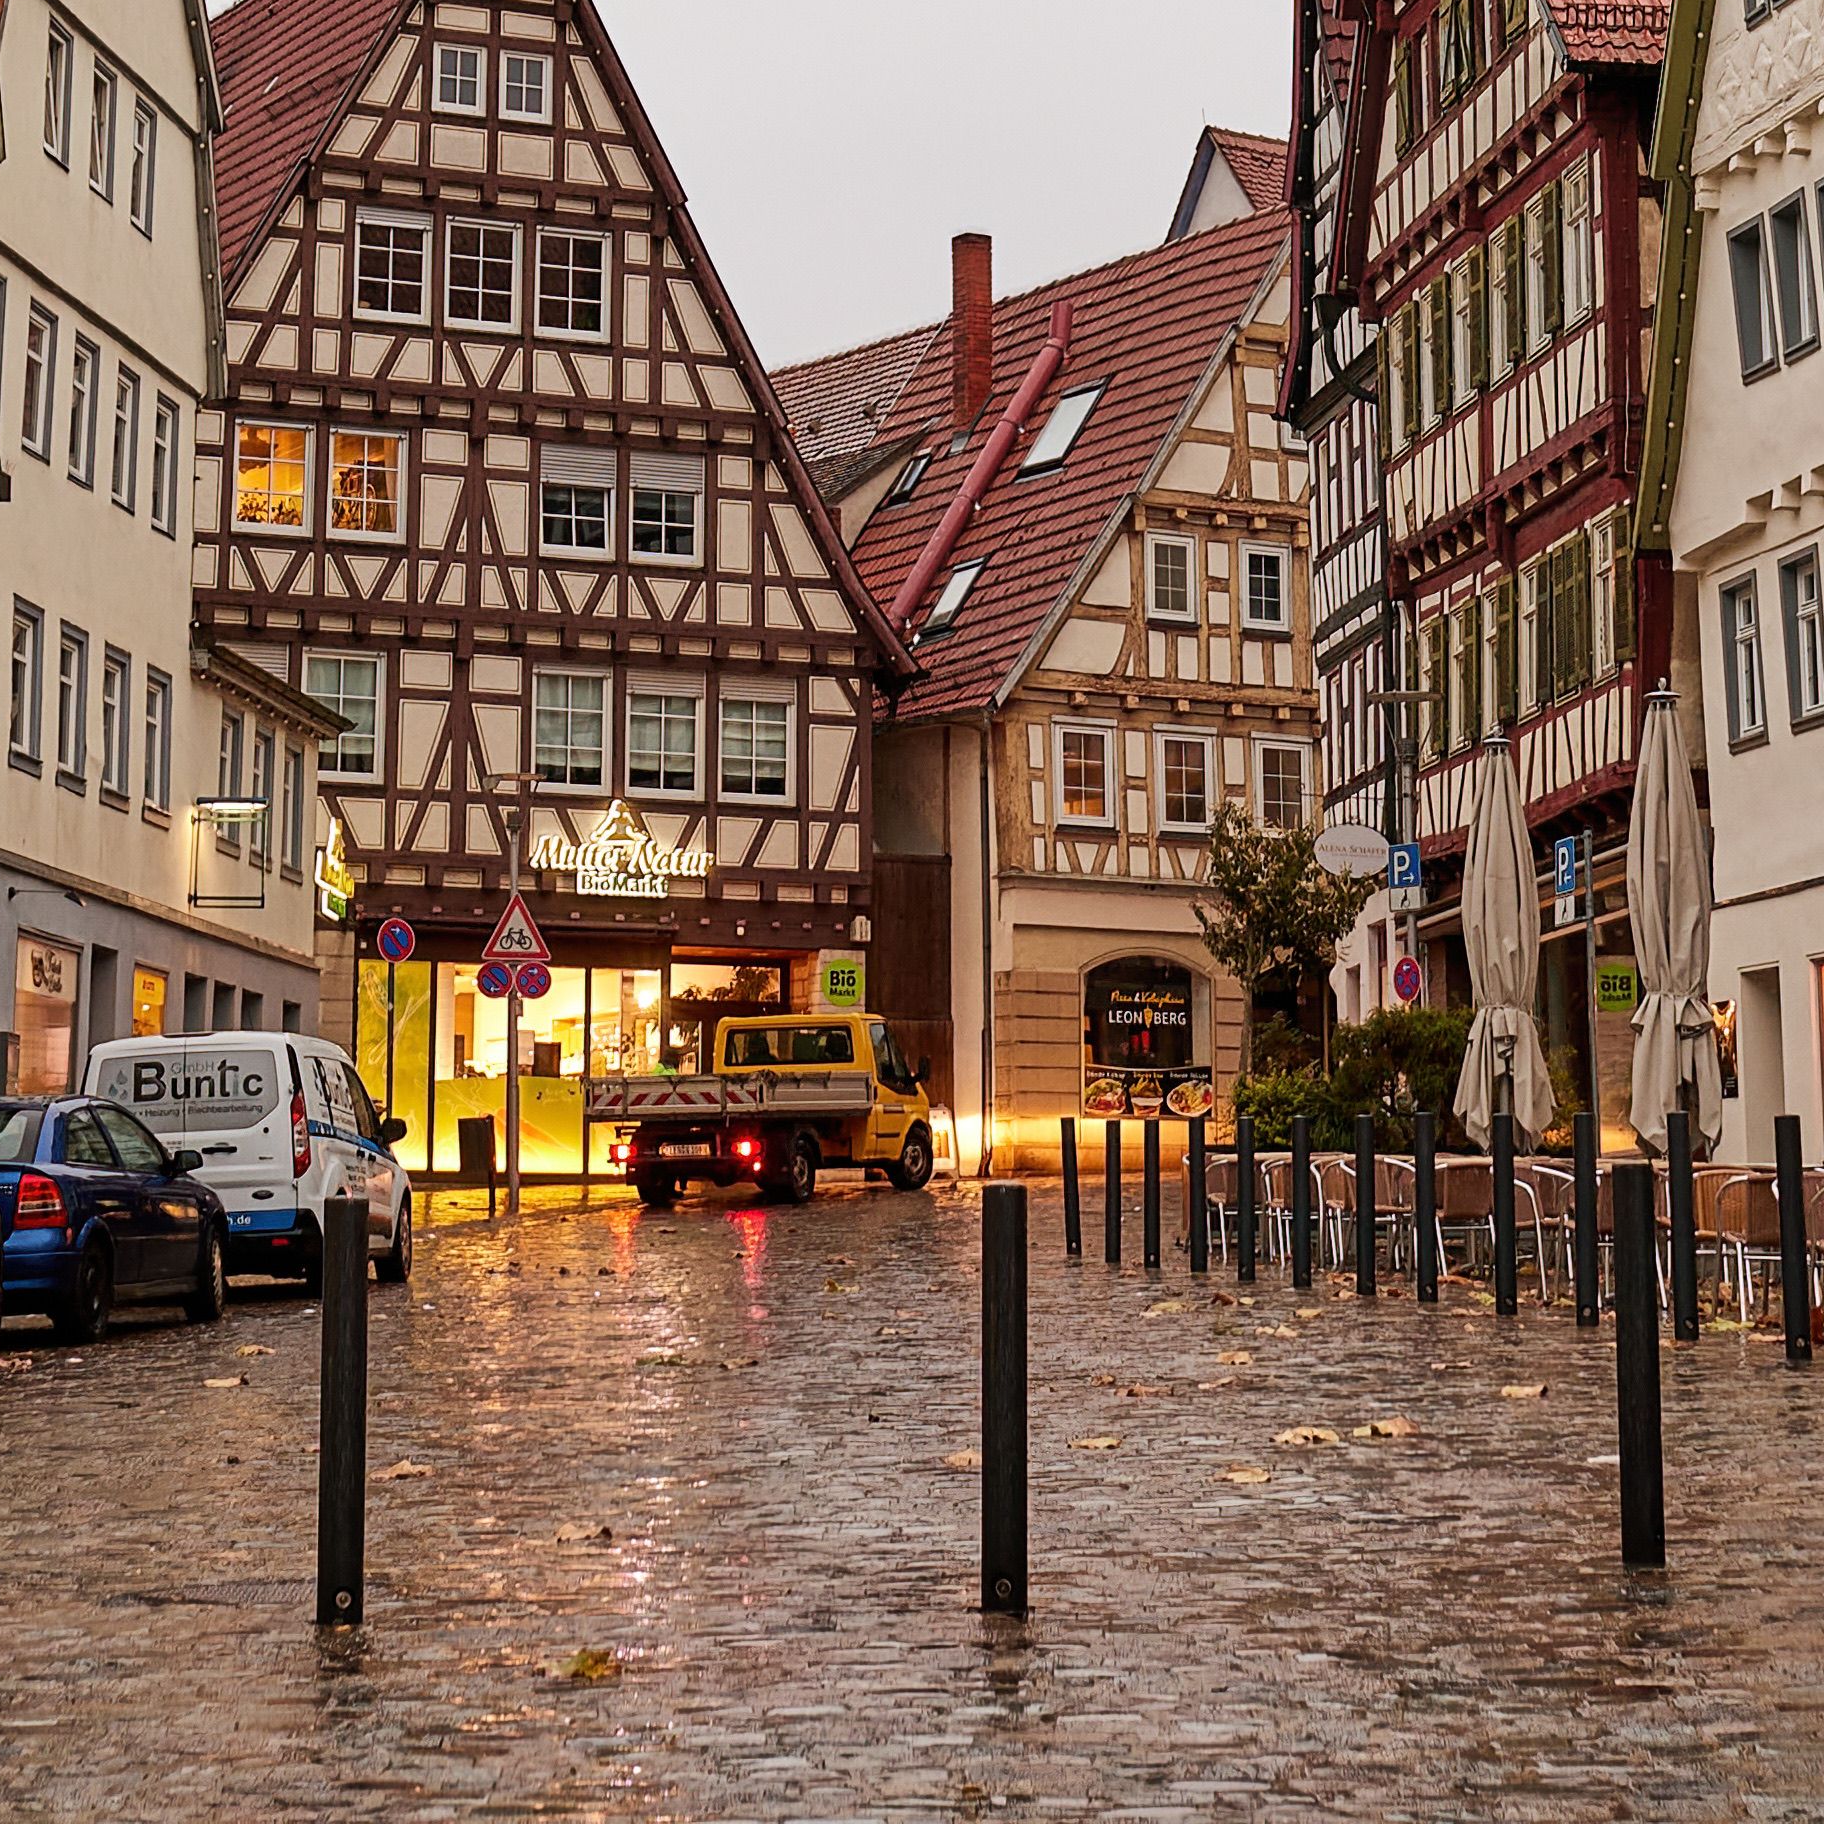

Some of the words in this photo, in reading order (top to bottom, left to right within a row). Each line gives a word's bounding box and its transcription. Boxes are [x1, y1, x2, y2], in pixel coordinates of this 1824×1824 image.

[1318, 843, 1347, 853] ALENA
[1393, 850, 1410, 885] P
[1558, 846, 1569, 887] P
[830, 987, 856, 997] Markt
[171, 1061, 215, 1073] GmbH
